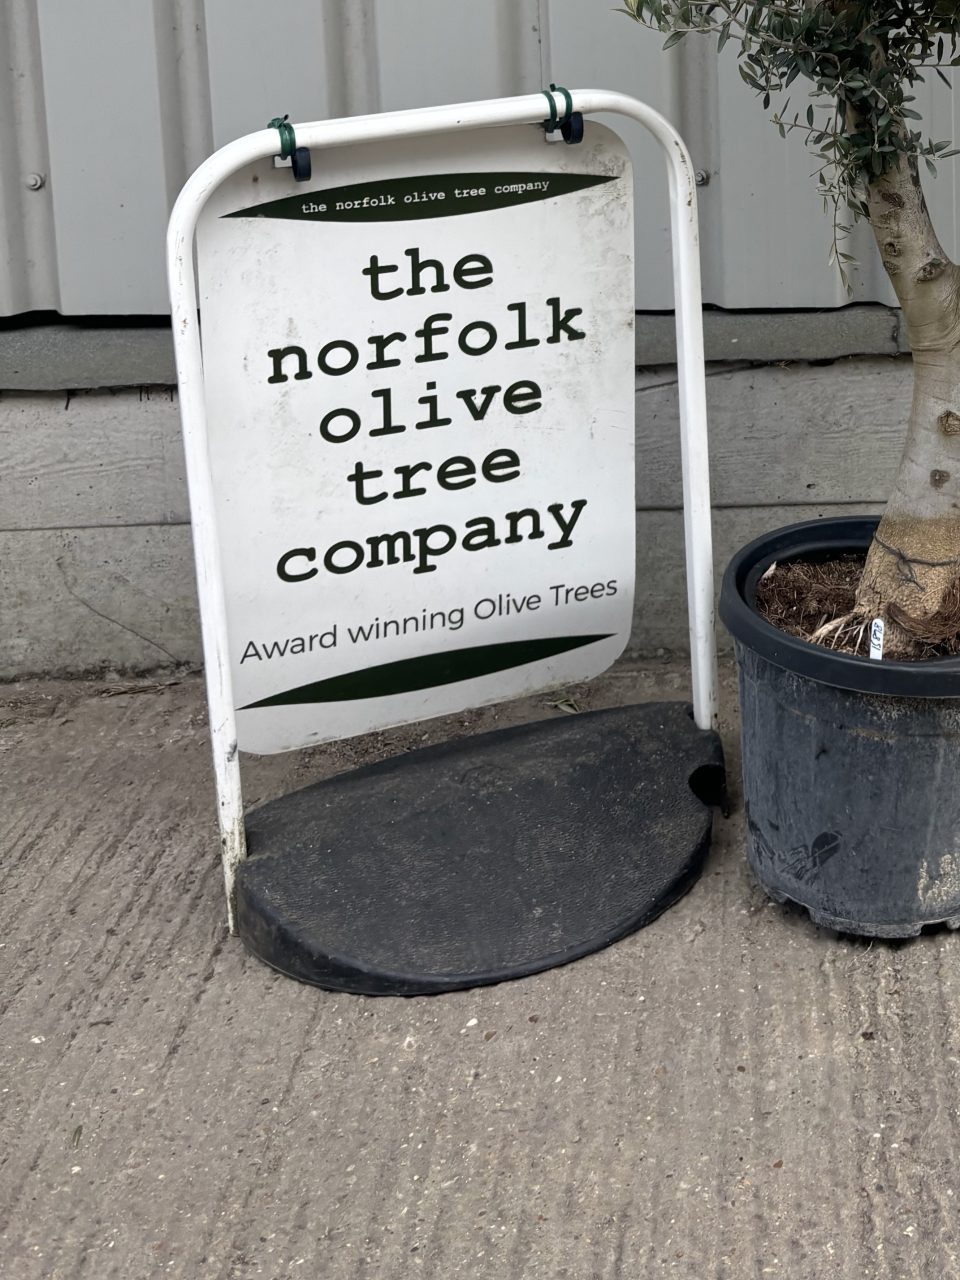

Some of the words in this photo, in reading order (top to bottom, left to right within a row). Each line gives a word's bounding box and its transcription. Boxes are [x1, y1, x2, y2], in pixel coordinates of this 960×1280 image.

[301, 202, 328, 214] the
[335, 195, 396, 211] norfolk
[403, 191, 446, 204] olive
[454, 187, 487, 199] tree
[494, 180, 550, 195] company
[362, 247, 494, 301] the
[267, 297, 586, 384] norfolk
[319, 380, 542, 444] olive
[346, 448, 521, 506] tree
[276, 499, 588, 583] company
[240, 623, 338, 665] Award
[347, 605, 465, 645] winning
[474, 591, 542, 621] Olive
[549, 578, 618, 607] Trees
